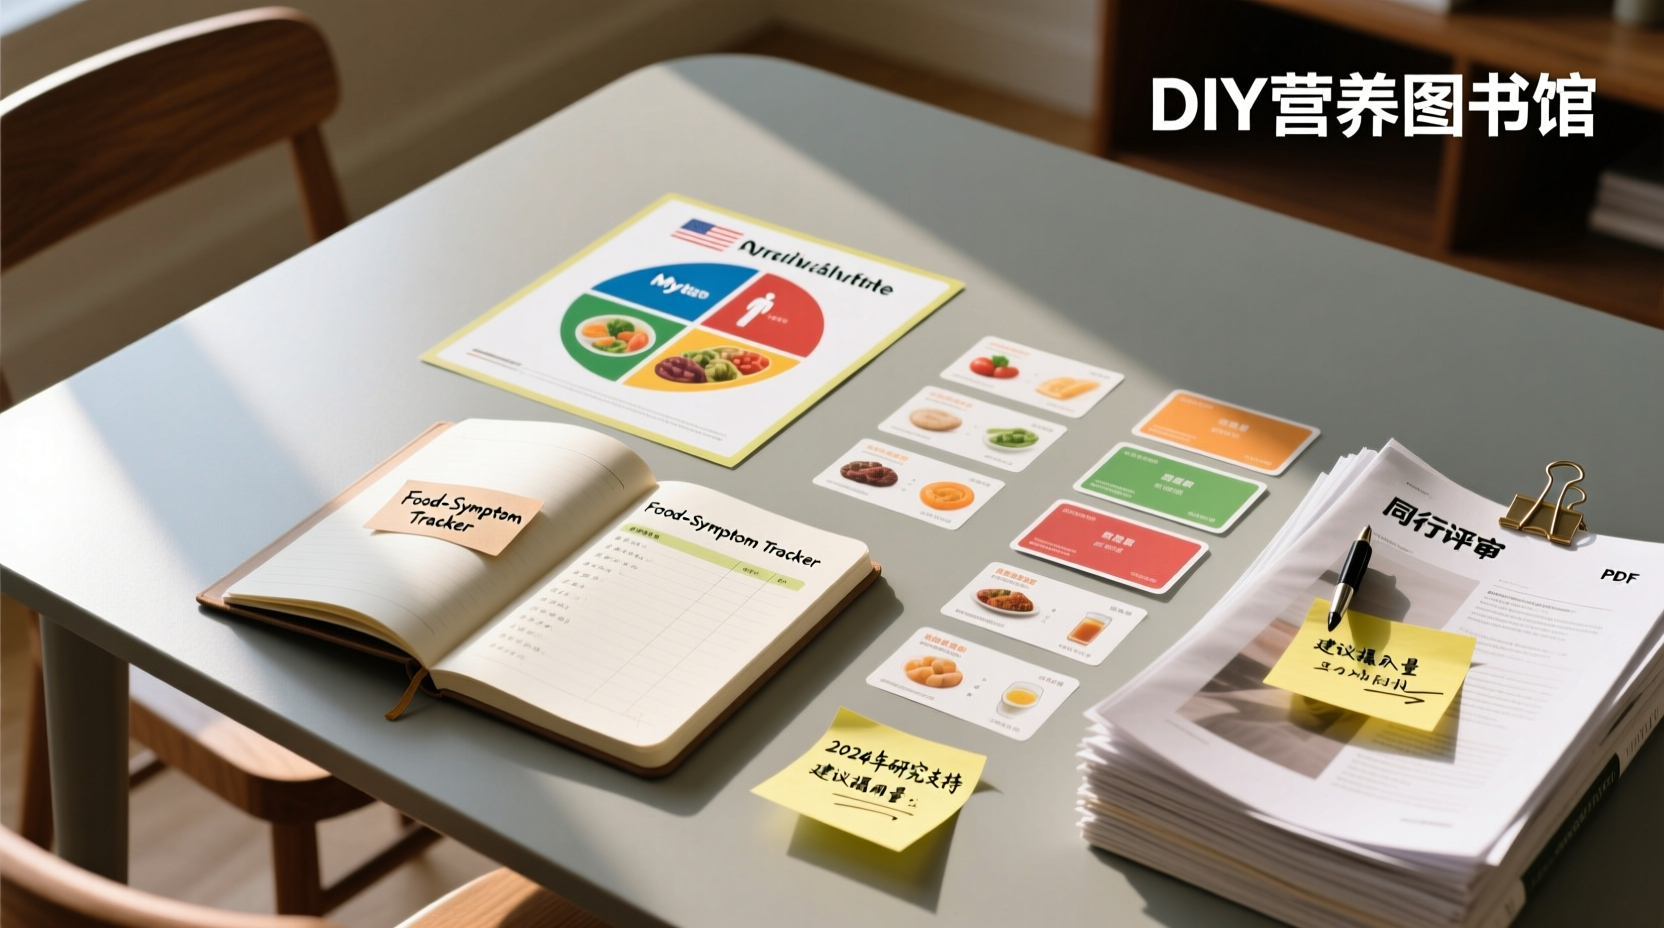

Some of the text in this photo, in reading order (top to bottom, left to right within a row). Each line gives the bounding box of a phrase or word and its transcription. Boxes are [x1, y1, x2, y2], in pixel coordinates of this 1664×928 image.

[401, 490, 522, 525] Food-Symptom
[410, 511, 475, 532] Tracker
[1382, 496, 1506, 560] 同行评审
[644, 501, 821, 568] Food-Symptom Tracker
[1600, 568, 1641, 585] PDF
[825, 740, 963, 795] 2024年研究支持
